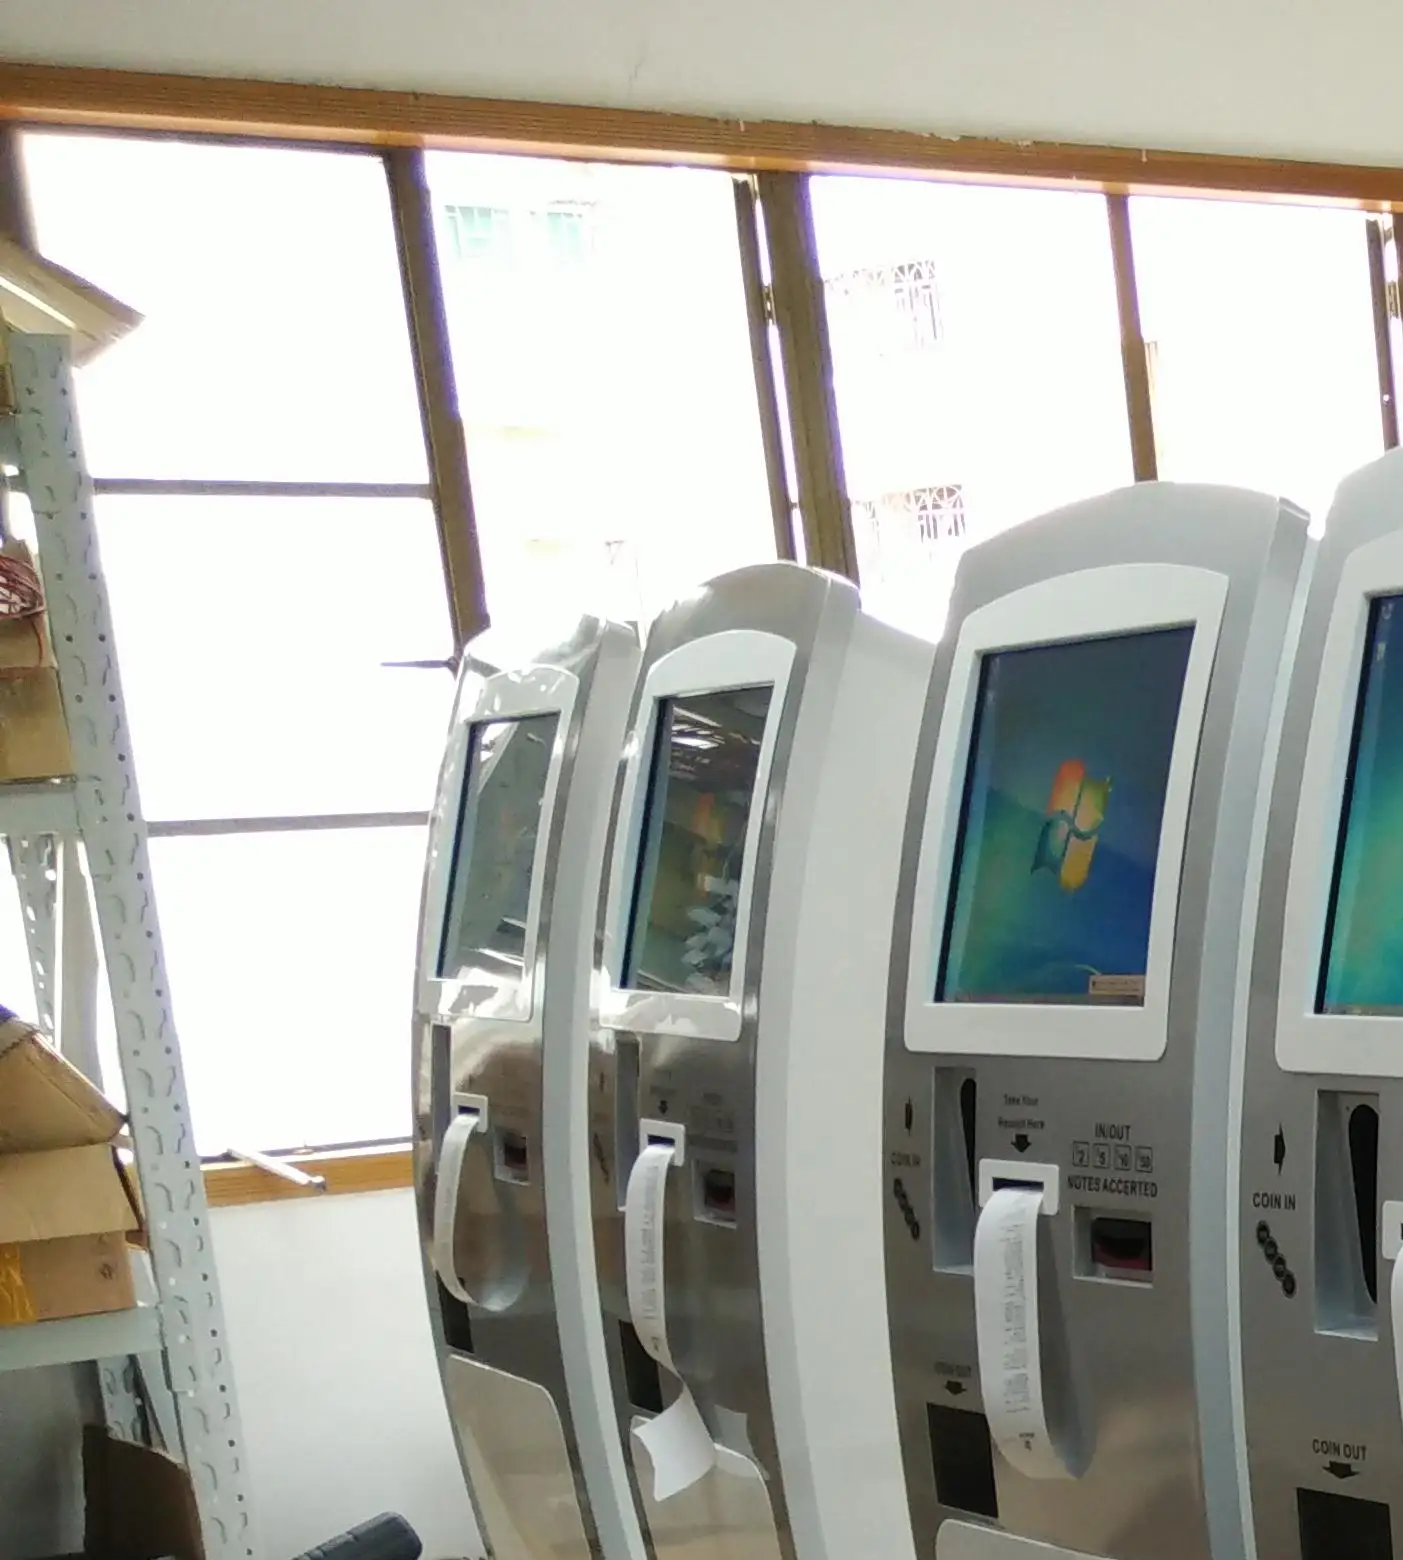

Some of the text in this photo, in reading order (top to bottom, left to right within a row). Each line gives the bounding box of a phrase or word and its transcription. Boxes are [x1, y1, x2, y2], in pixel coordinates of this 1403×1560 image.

[1252, 1191, 1296, 1212] COIN IN
[1312, 1438, 1367, 1461] COIN OUT
